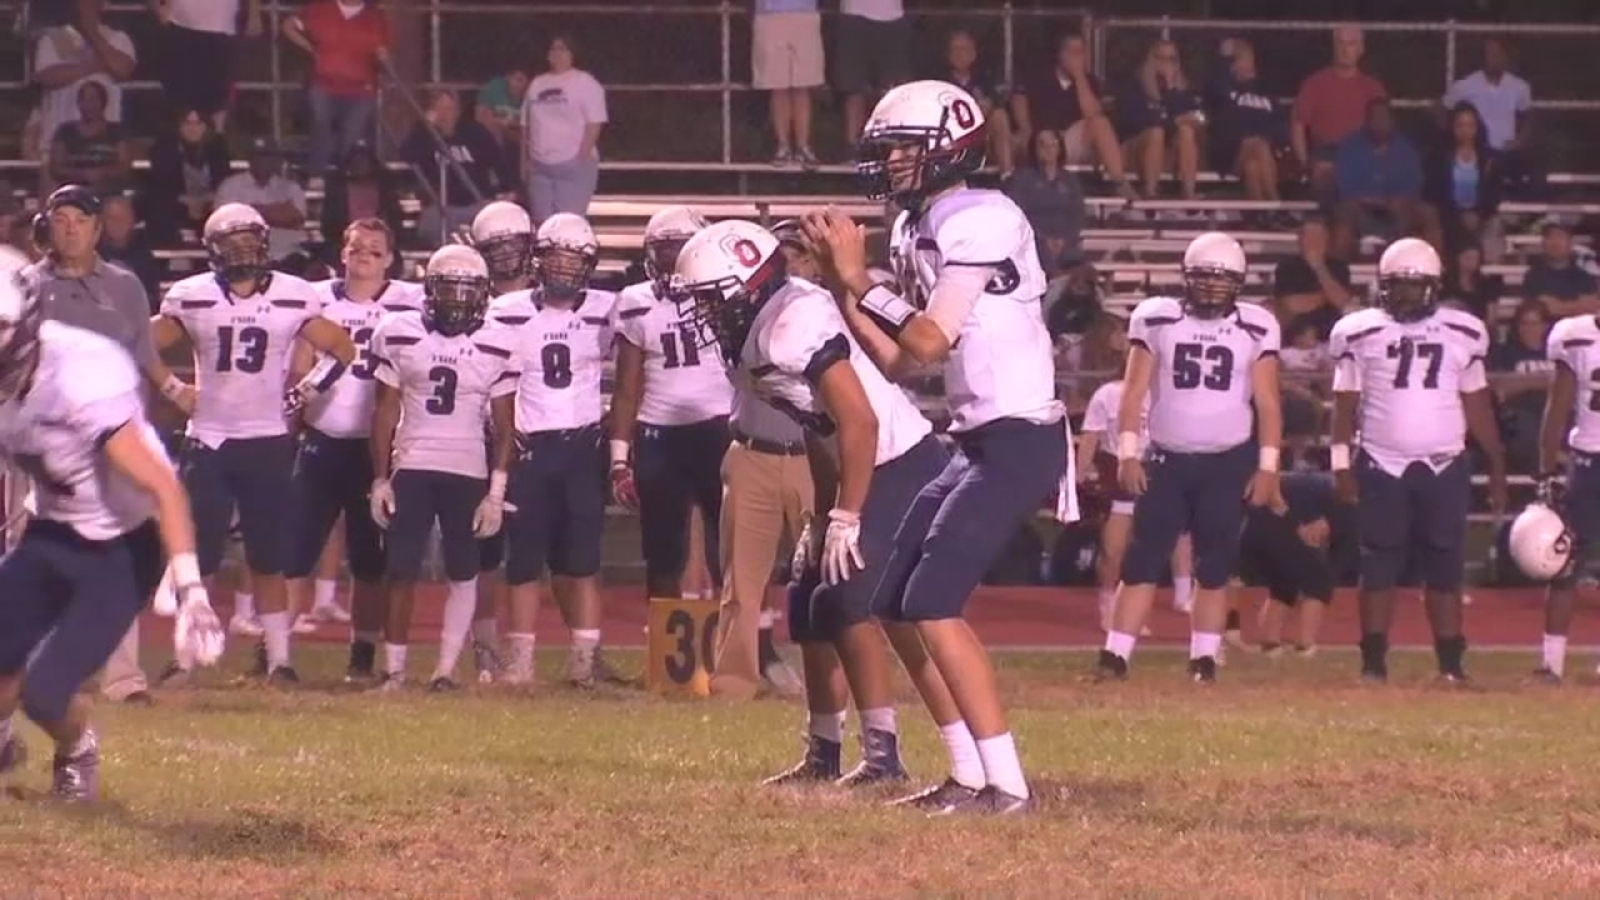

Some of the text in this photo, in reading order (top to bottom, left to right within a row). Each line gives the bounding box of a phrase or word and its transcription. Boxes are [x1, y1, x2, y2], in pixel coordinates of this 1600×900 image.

[216, 325, 268, 373] 13
[344, 327, 377, 379] 3
[541, 343, 572, 389] 8
[1173, 343, 1234, 391] 53
[1386, 341, 1443, 389] 77
[426, 366, 458, 415] 3
